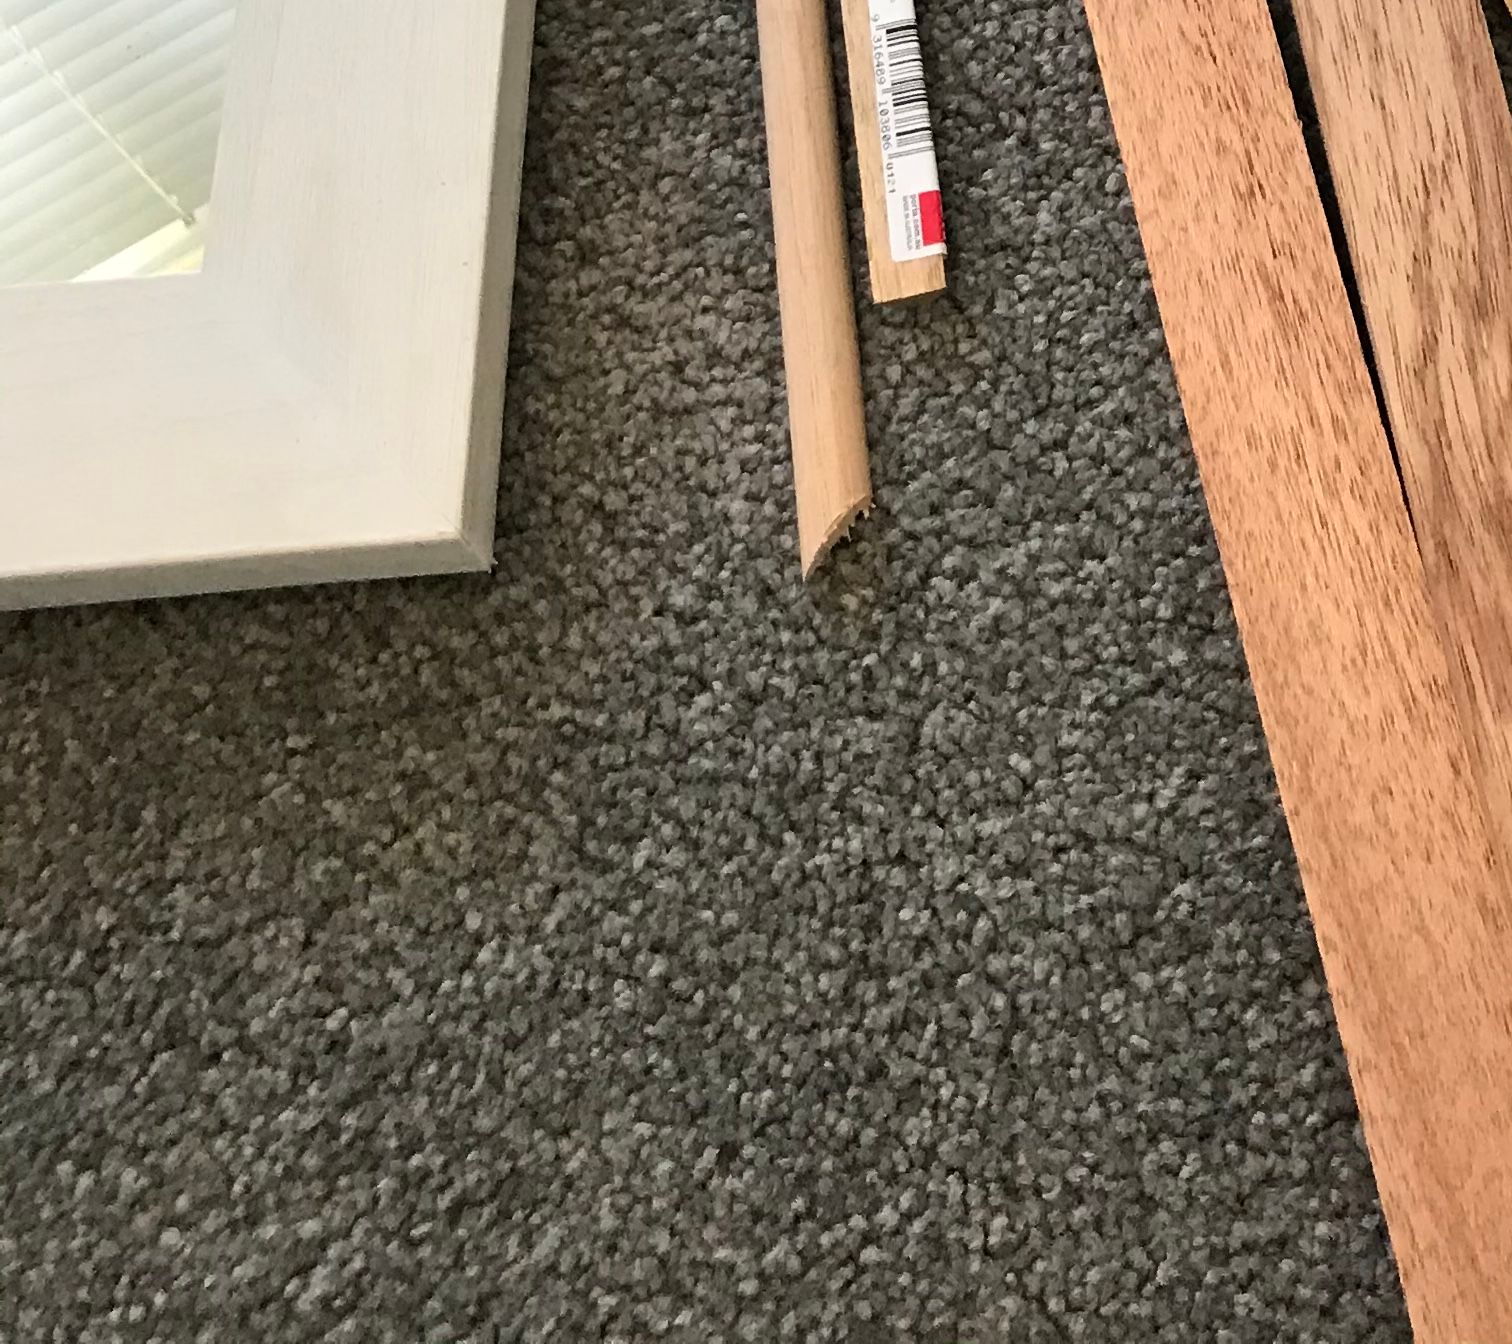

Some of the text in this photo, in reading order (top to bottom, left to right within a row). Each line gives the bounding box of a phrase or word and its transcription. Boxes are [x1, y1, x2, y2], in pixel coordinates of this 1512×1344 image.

[871, 13, 893, 151] 9 316489 103806
